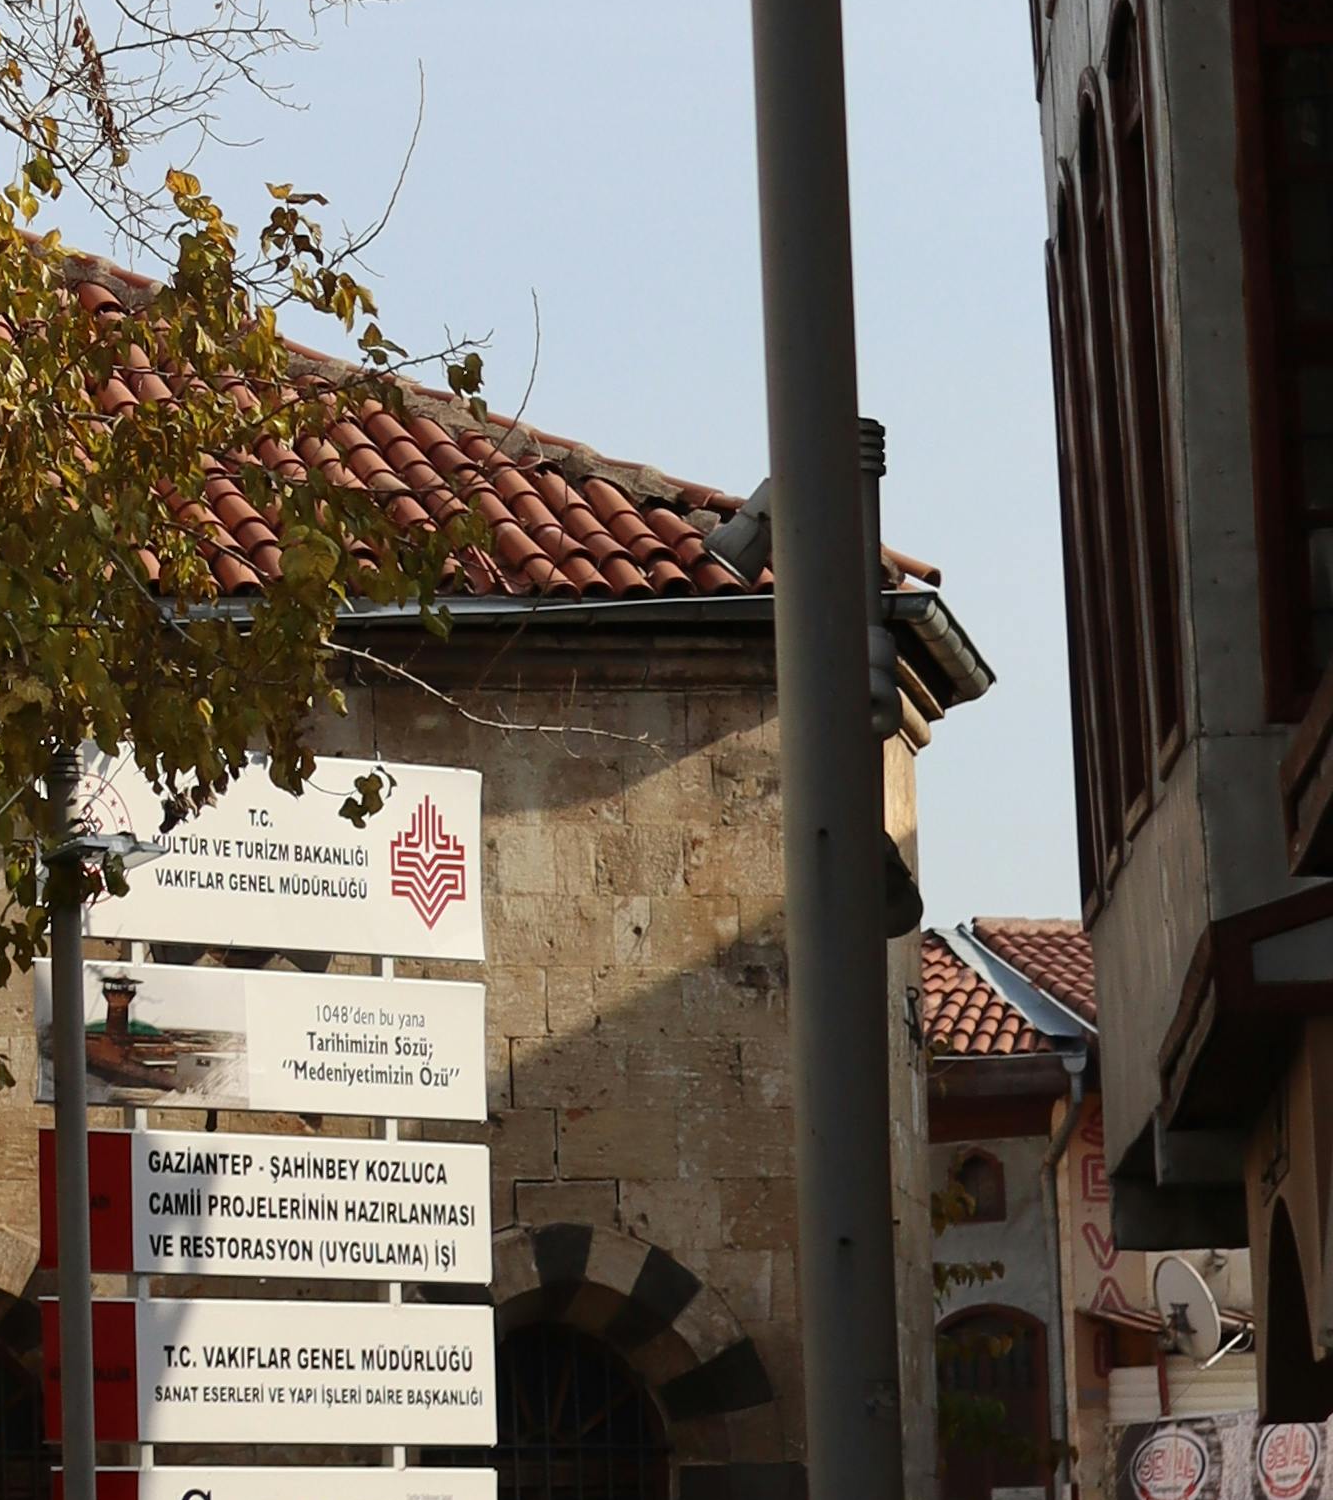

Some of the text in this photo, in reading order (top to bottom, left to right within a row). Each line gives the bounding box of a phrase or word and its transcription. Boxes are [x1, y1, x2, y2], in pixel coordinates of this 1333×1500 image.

[248, 808, 273, 828] T.C.
[212, 839, 232, 858] VE
[235, 838, 289, 861] TURİZM
[294, 844, 369, 867] BAKANLIĞI
[155, 868, 368, 900] VAKIFLAR GENEL MÜDÜRLÜĞÜ
[379, 1008, 393, 1027] bu
[398, 1013, 425, 1030] yana
[306, 1030, 433, 1060] Tarihimizin Sözü;
[148, 1147, 253, 1176] GAZİANTEP
[270, 1152, 360, 1183] ŞAHİNBEY
[366, 1160, 448, 1185] KOZLUCA
[149, 1188, 475, 1227] CAMİİ PROJELERİNİN HAZIRLANMASI
[149, 1233, 456, 1272] VE RESTORASYON (UYGULAMA) İŞİ
[163, 1344, 473, 1373] T.C. VAKIFLAR GENEL MÜDÜRLÜĞÜ
[155, 1383, 483, 1409] SANAT ESERLERİ VE YAPI İŞLERİ DAİRE BAŞKANLIĞI
